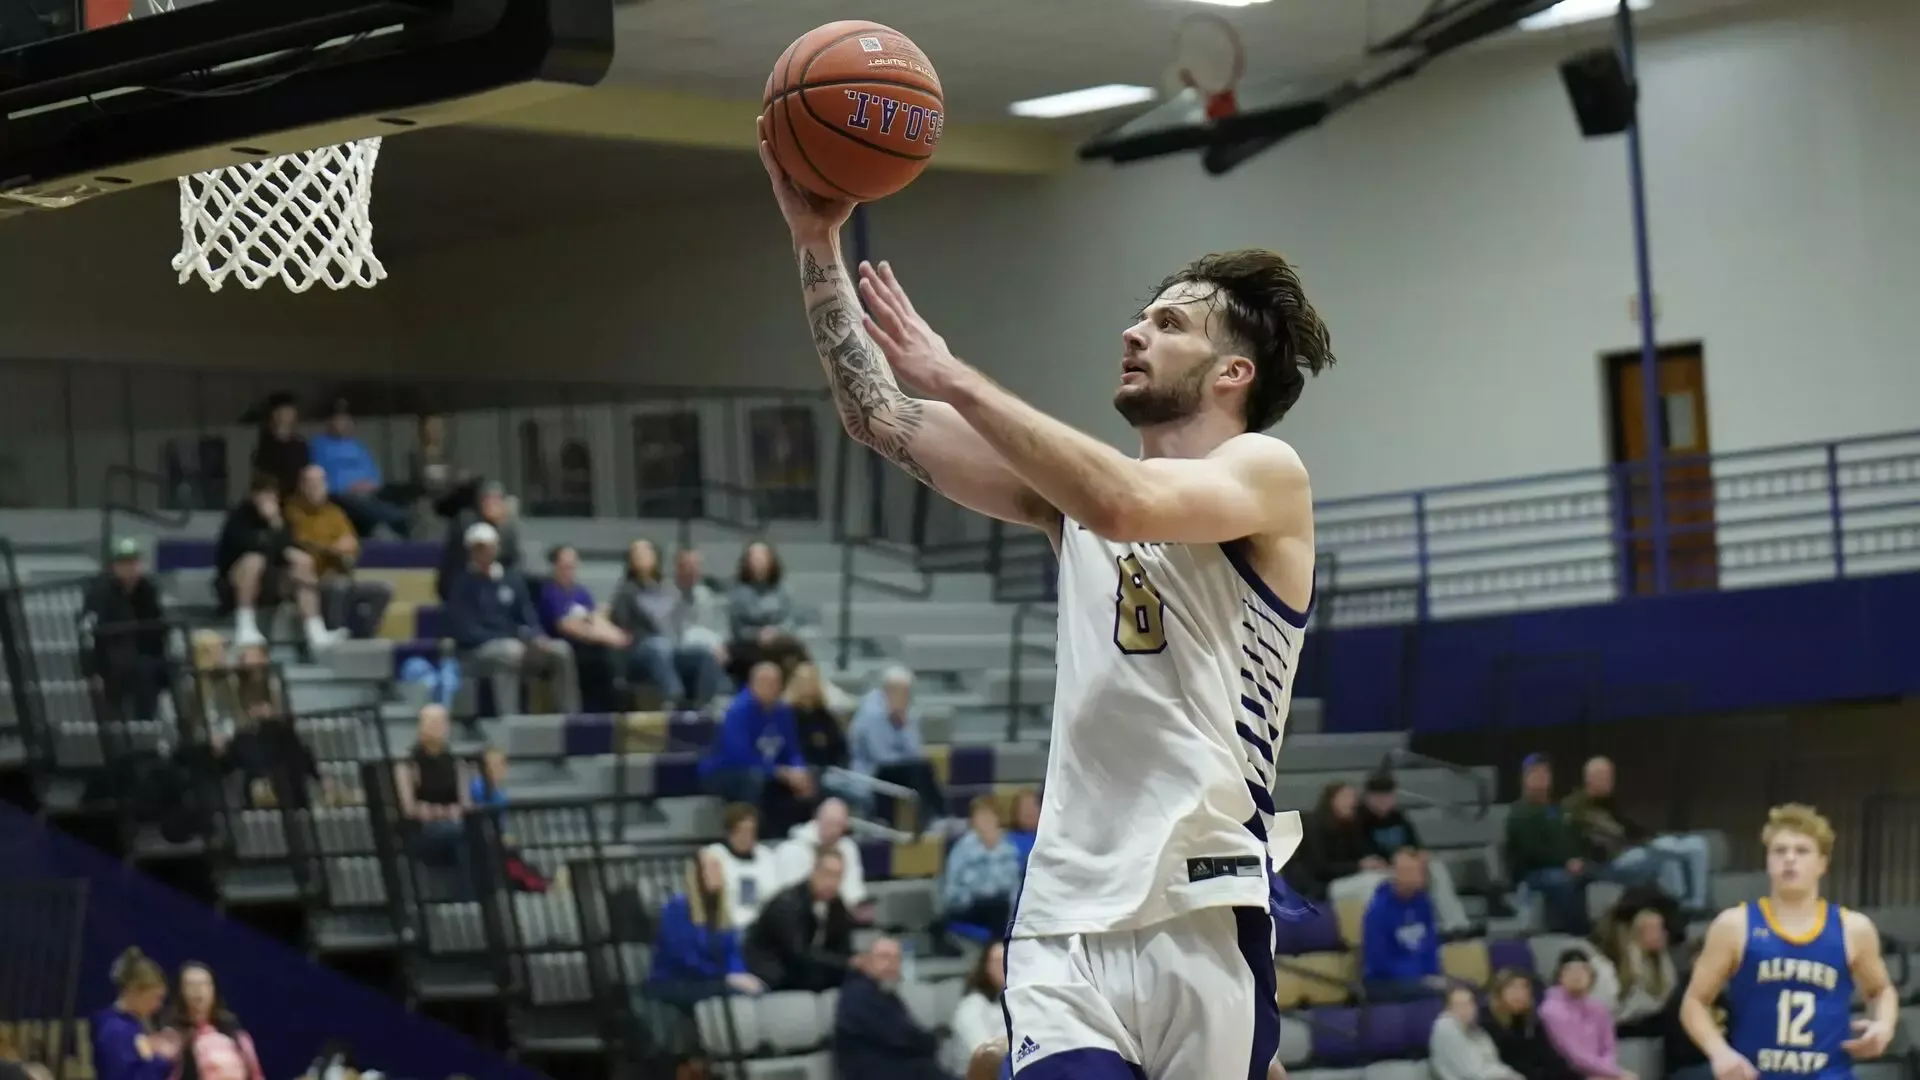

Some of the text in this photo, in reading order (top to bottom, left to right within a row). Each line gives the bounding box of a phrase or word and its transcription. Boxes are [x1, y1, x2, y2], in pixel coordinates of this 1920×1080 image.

[1113, 552, 1168, 655] 8
[1757, 957, 1838, 992] ALFRED
[1775, 988, 1816, 1047] 12
